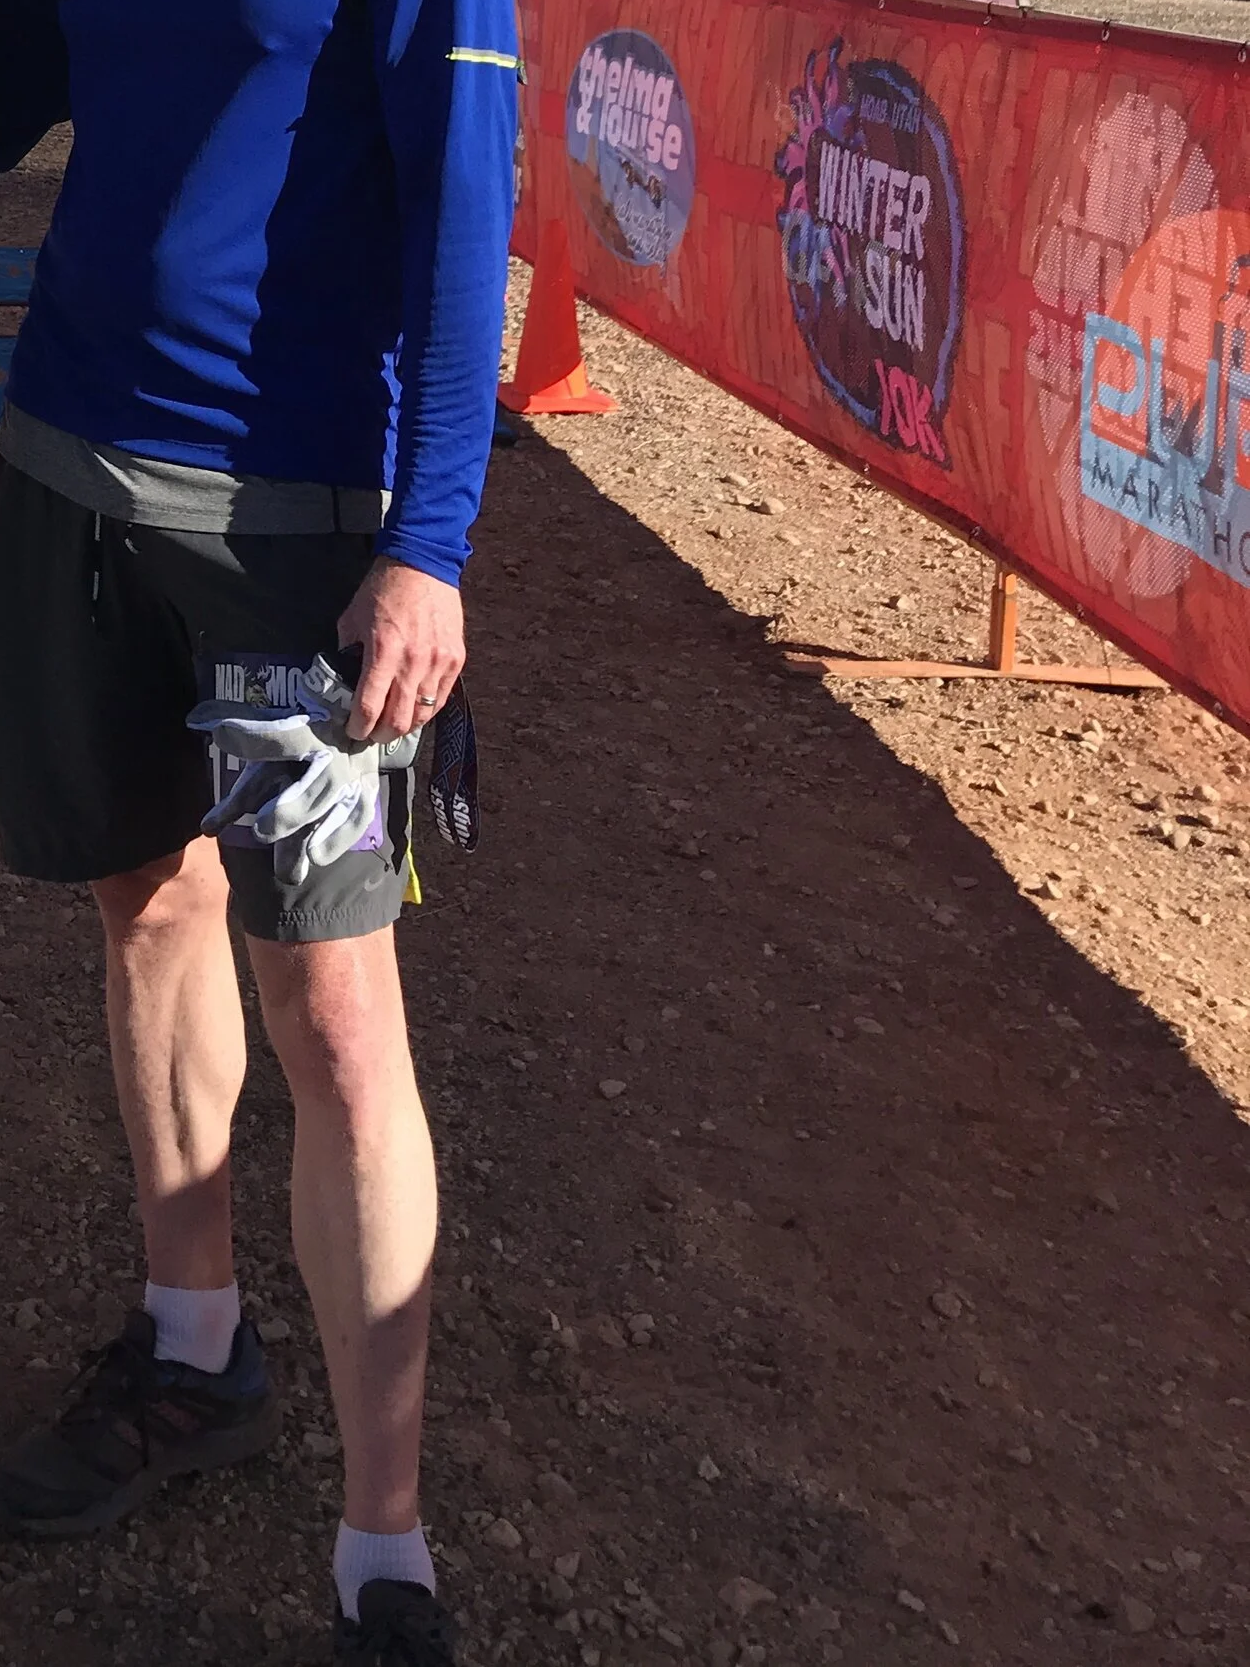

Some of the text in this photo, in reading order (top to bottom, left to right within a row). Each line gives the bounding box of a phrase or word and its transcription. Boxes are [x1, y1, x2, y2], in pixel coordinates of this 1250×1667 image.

[579, 46, 674, 118] thelma
[817, 139, 932, 263] WINTER
[863, 246, 927, 353] SUN
